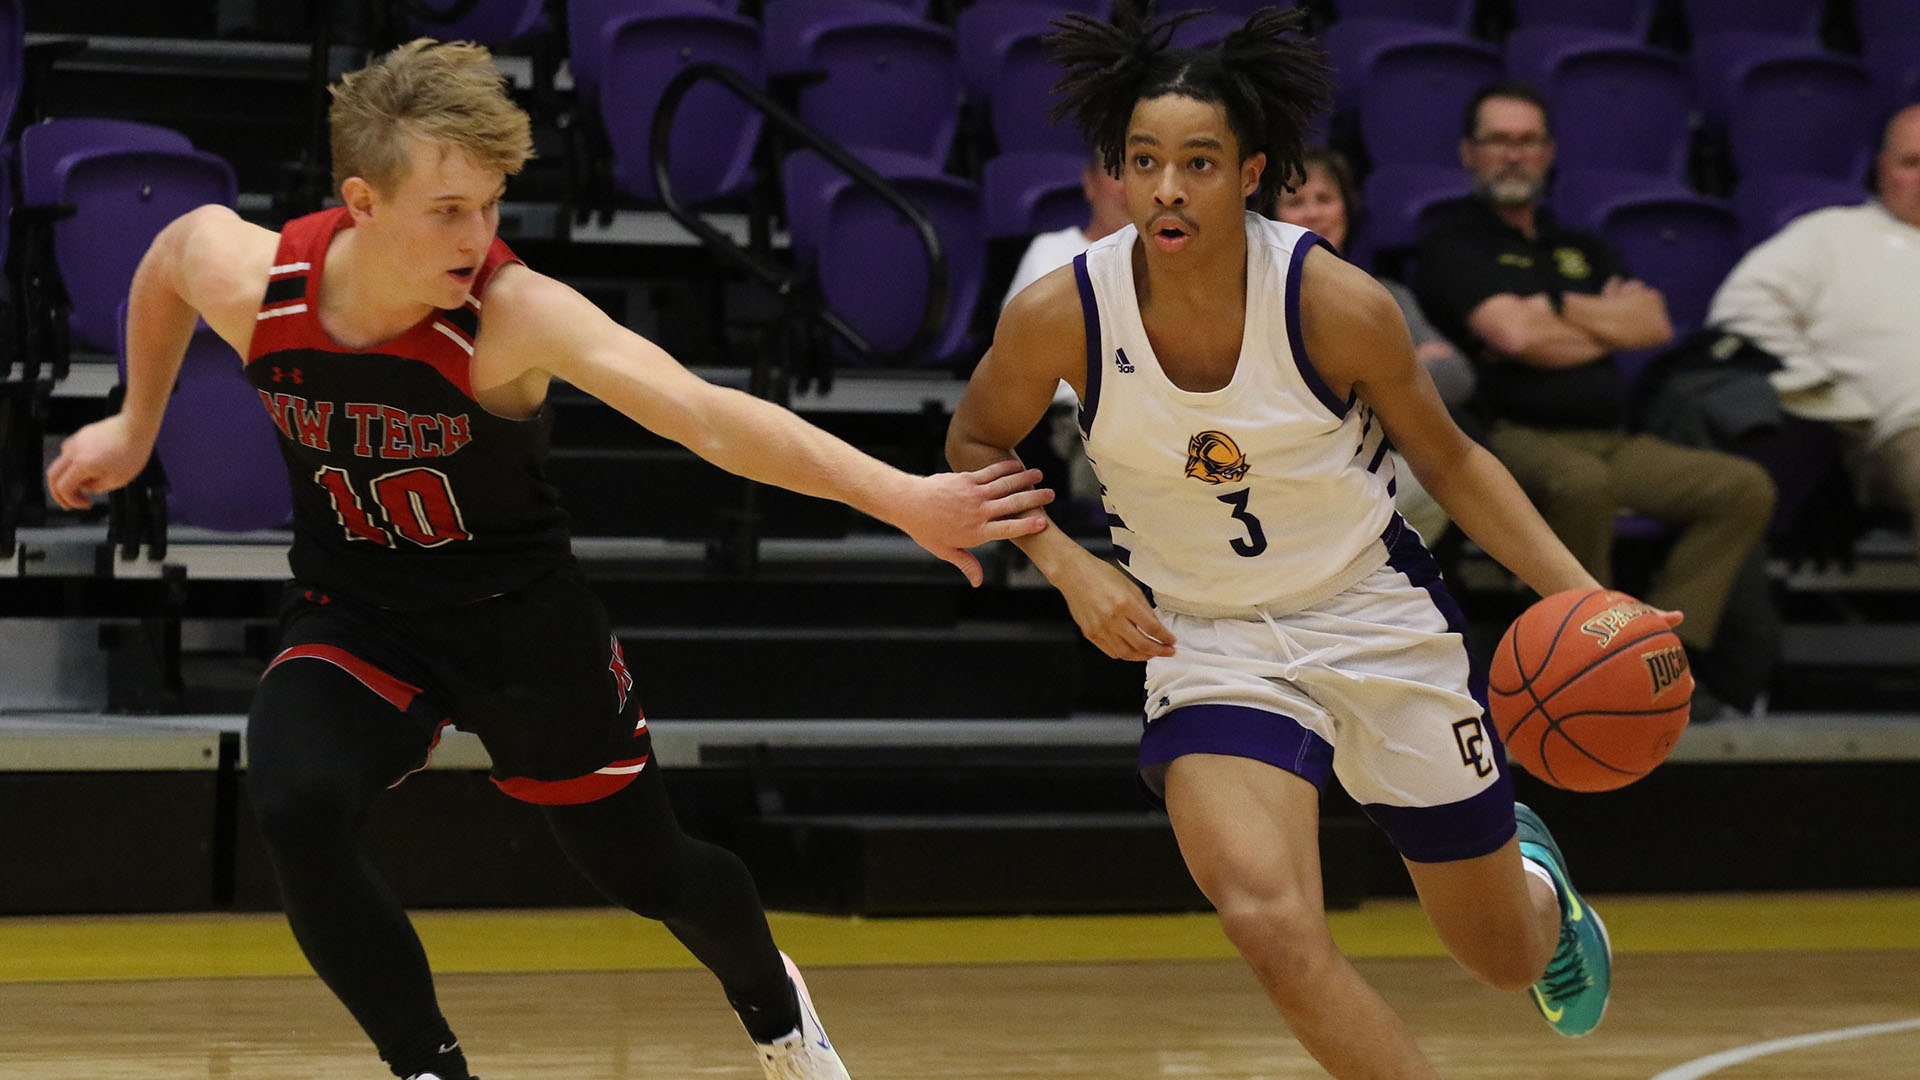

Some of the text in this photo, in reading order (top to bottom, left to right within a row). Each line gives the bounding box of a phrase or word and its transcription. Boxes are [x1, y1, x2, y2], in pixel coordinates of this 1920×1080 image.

[257, 387, 472, 460] NW TECH
[314, 464, 473, 549] 10
[1216, 487, 1268, 558] 3
